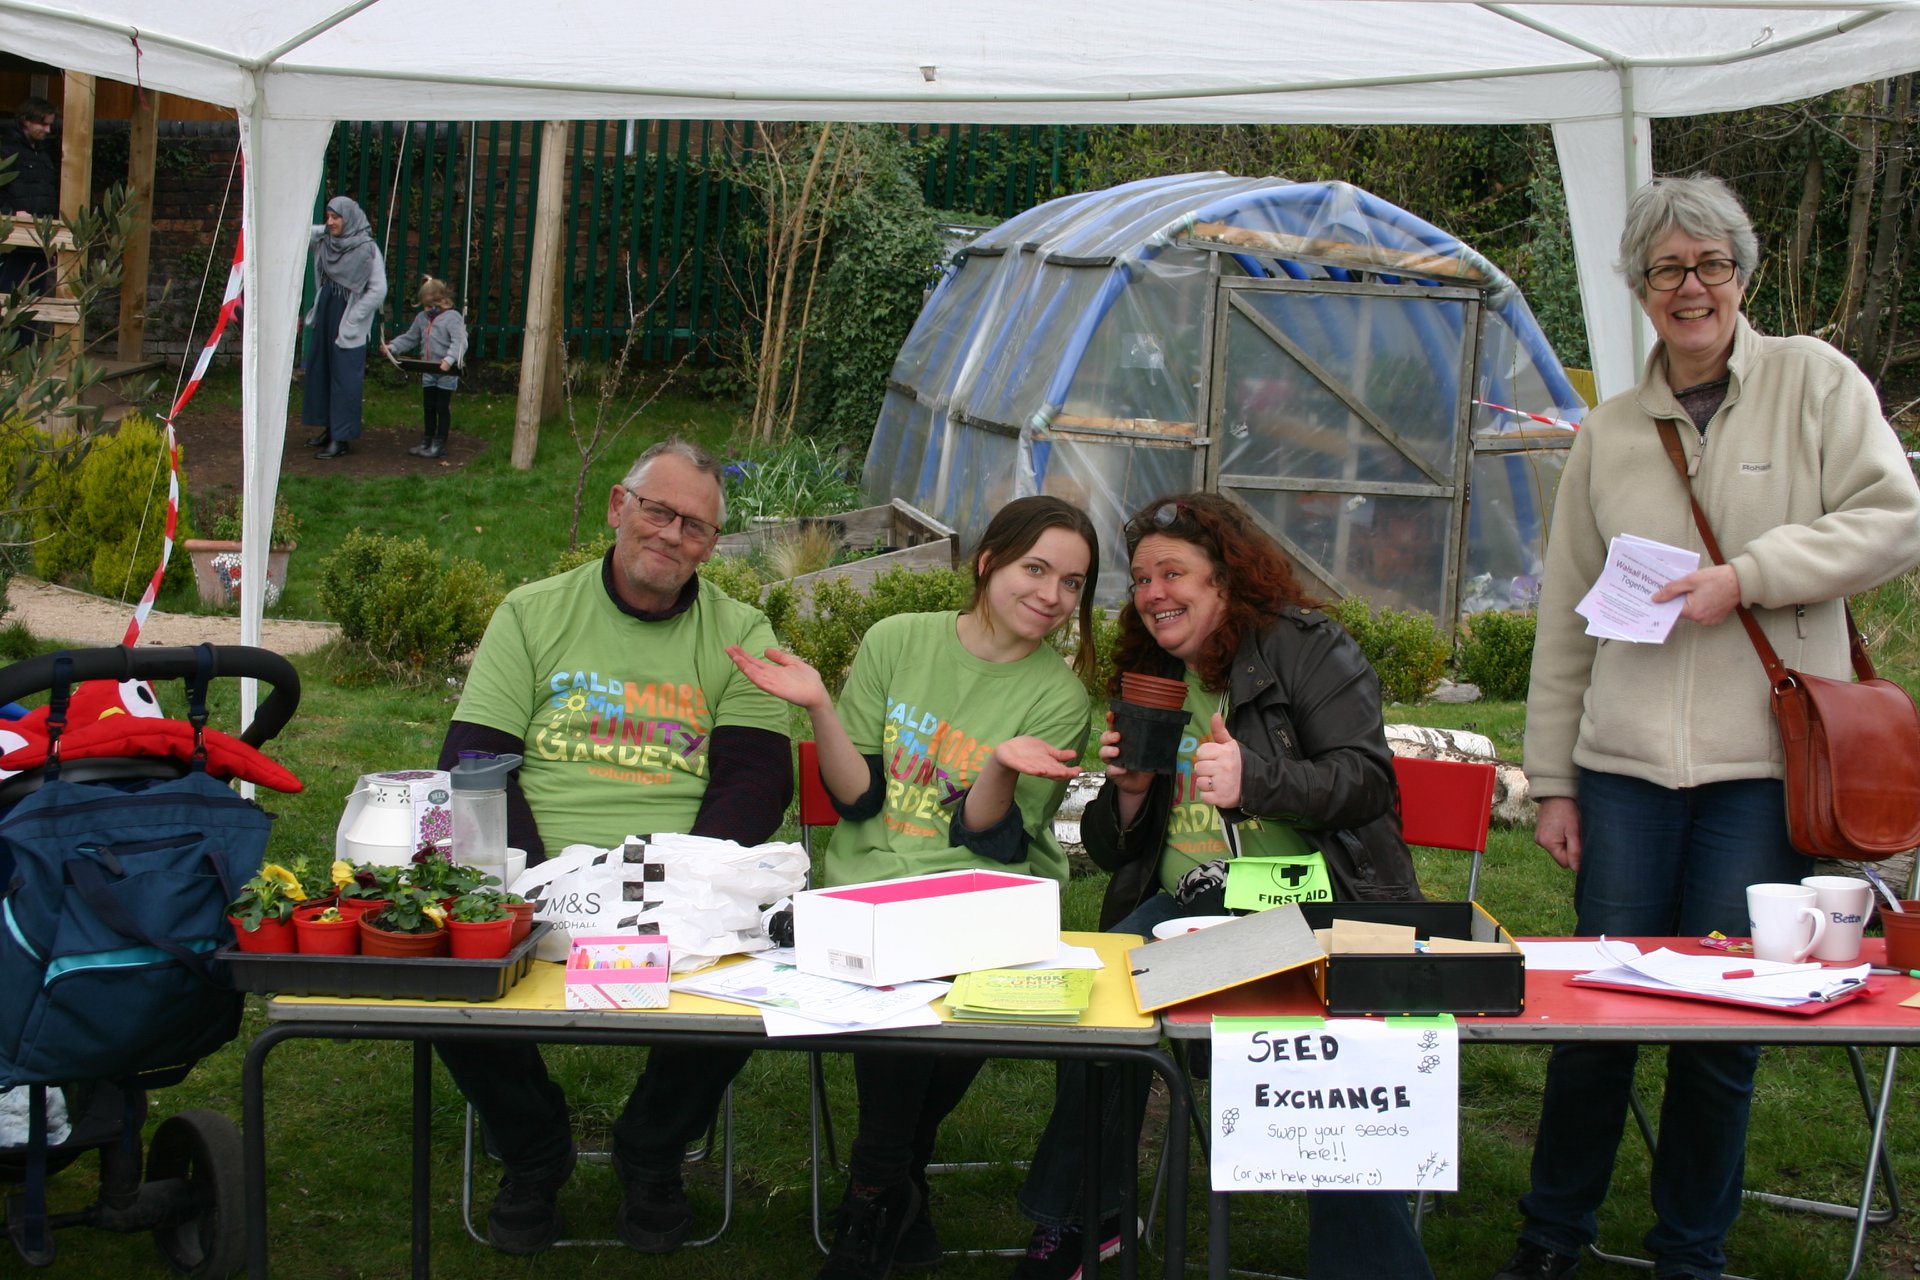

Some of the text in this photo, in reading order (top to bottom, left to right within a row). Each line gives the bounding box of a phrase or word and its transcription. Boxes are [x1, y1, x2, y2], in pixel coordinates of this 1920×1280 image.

[1616, 560, 1641, 580] Walsall
[1621, 574, 1652, 596] Together
[589, 714, 706, 757] UNITY
[536, 727, 705, 776] GARDEN
[588, 766, 672, 784] volunteer
[547, 893, 601, 916] M&S
[1259, 889, 1328, 905] FIRST AID
[552, 921, 598, 931] OODHALL
[1831, 912, 1862, 924] Better
[1248, 1031, 1339, 1062] SEED
[1255, 1084, 1411, 1113] EXCHANGE
[1268, 1123, 1410, 1145] Swap your seeds
[1233, 1165, 1252, 1182] (or
[1255, 1169, 1277, 1182] just
[1281, 1170, 1307, 1184] help
[1311, 1172, 1362, 1188] yourself
